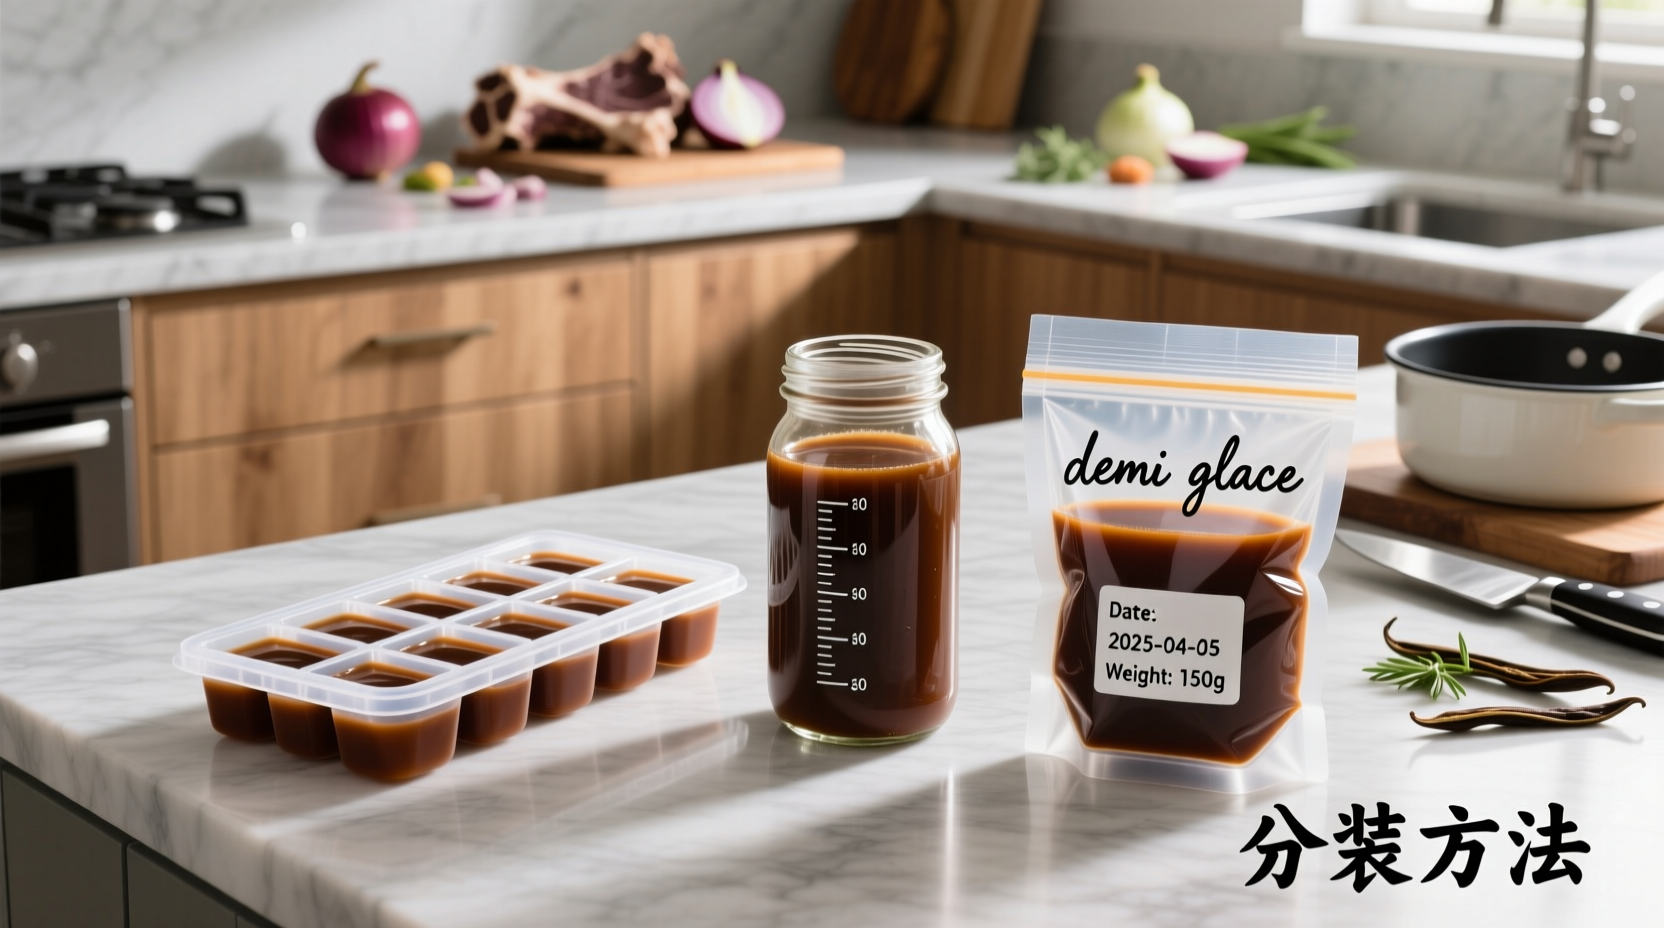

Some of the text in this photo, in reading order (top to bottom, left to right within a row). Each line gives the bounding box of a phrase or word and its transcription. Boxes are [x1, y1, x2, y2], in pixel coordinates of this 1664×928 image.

[1063, 430, 1304, 518] demi glace
[1109, 600, 1157, 622] Date:
[1108, 631, 1220, 657] 2025-04-05
[1105, 662, 1225, 695] Weight: 150g
